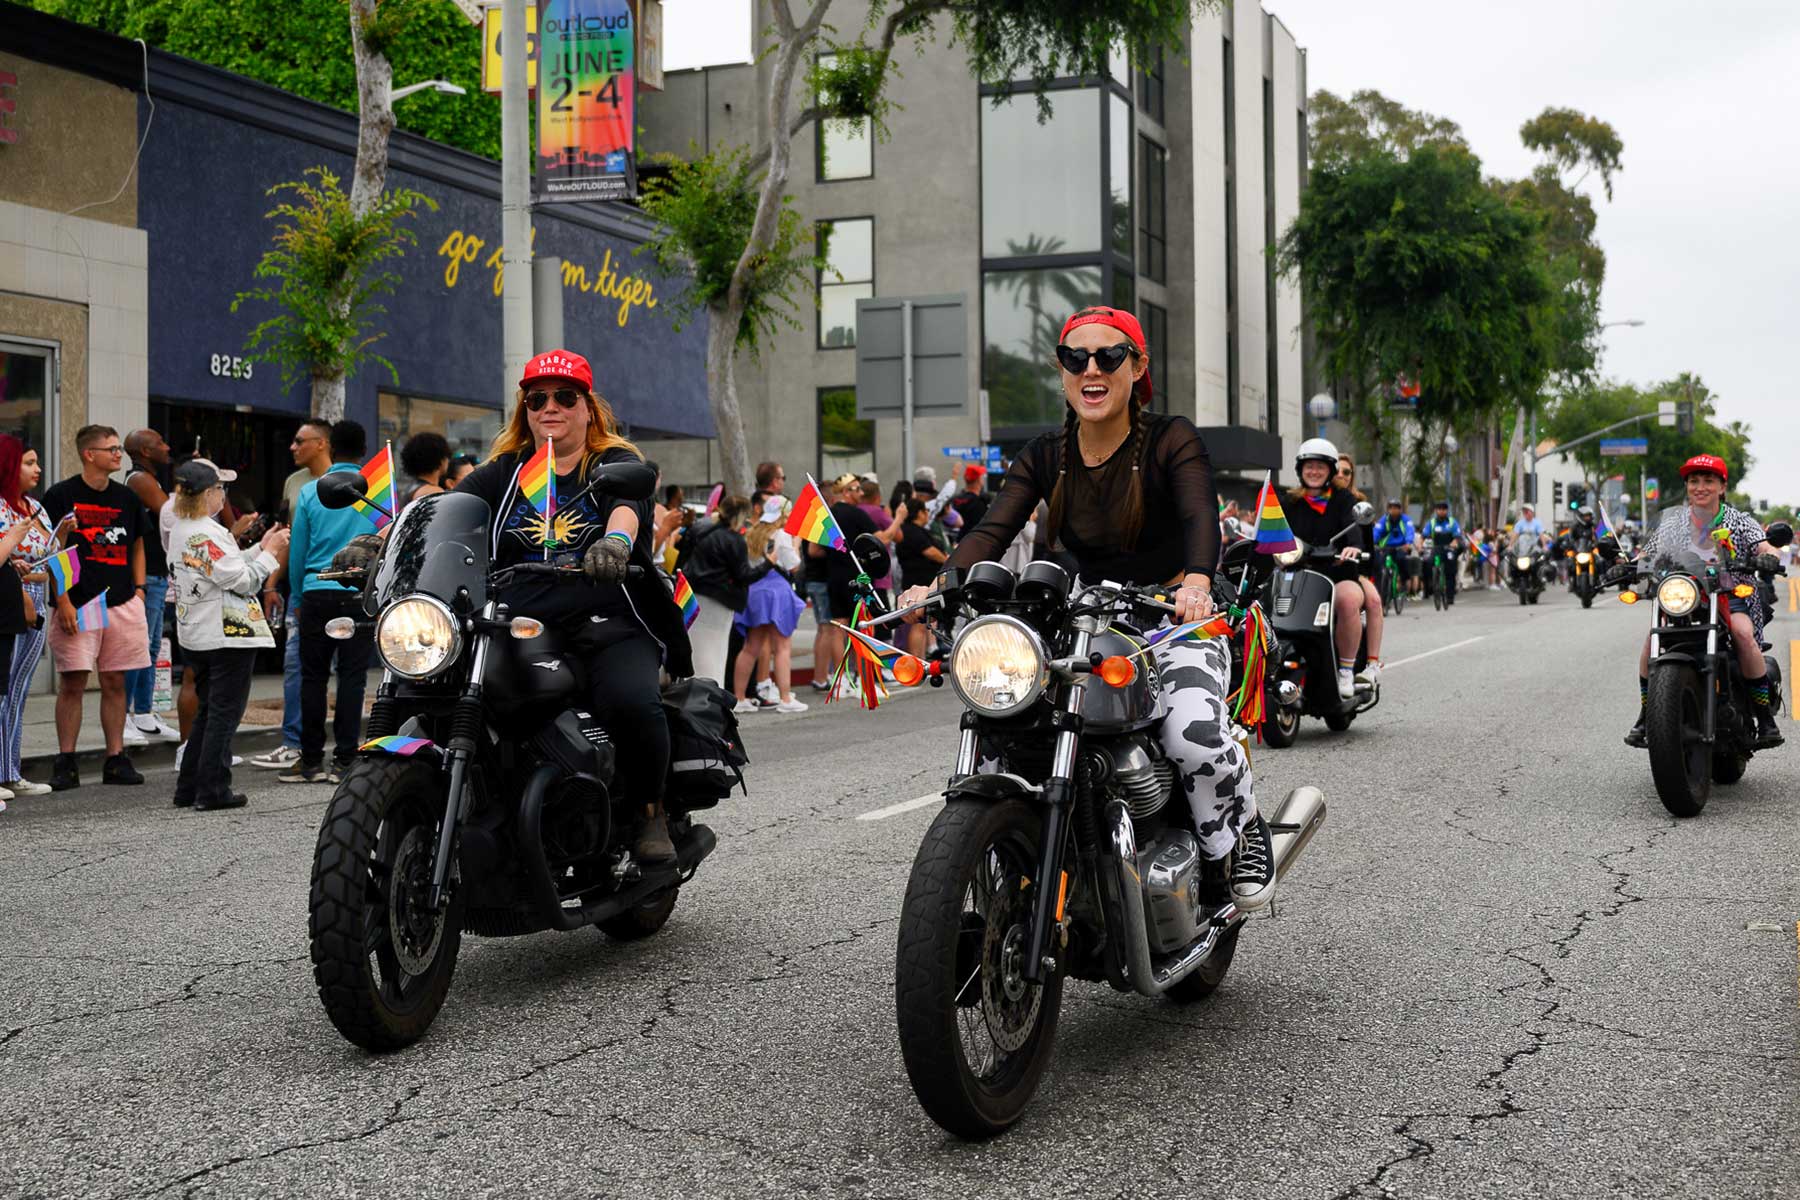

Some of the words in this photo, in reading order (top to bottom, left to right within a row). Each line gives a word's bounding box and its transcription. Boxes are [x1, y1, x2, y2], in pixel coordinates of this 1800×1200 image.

[545, 11, 629, 34] outloud
[551, 50, 624, 76] JUNE
[550, 74, 623, 112] 2-4
[547, 181, 626, 192] WeAreOUTLOUD.com
[438, 230, 485, 288] go
[594, 248, 658, 327] tiger
[211, 353, 253, 379] 8253
